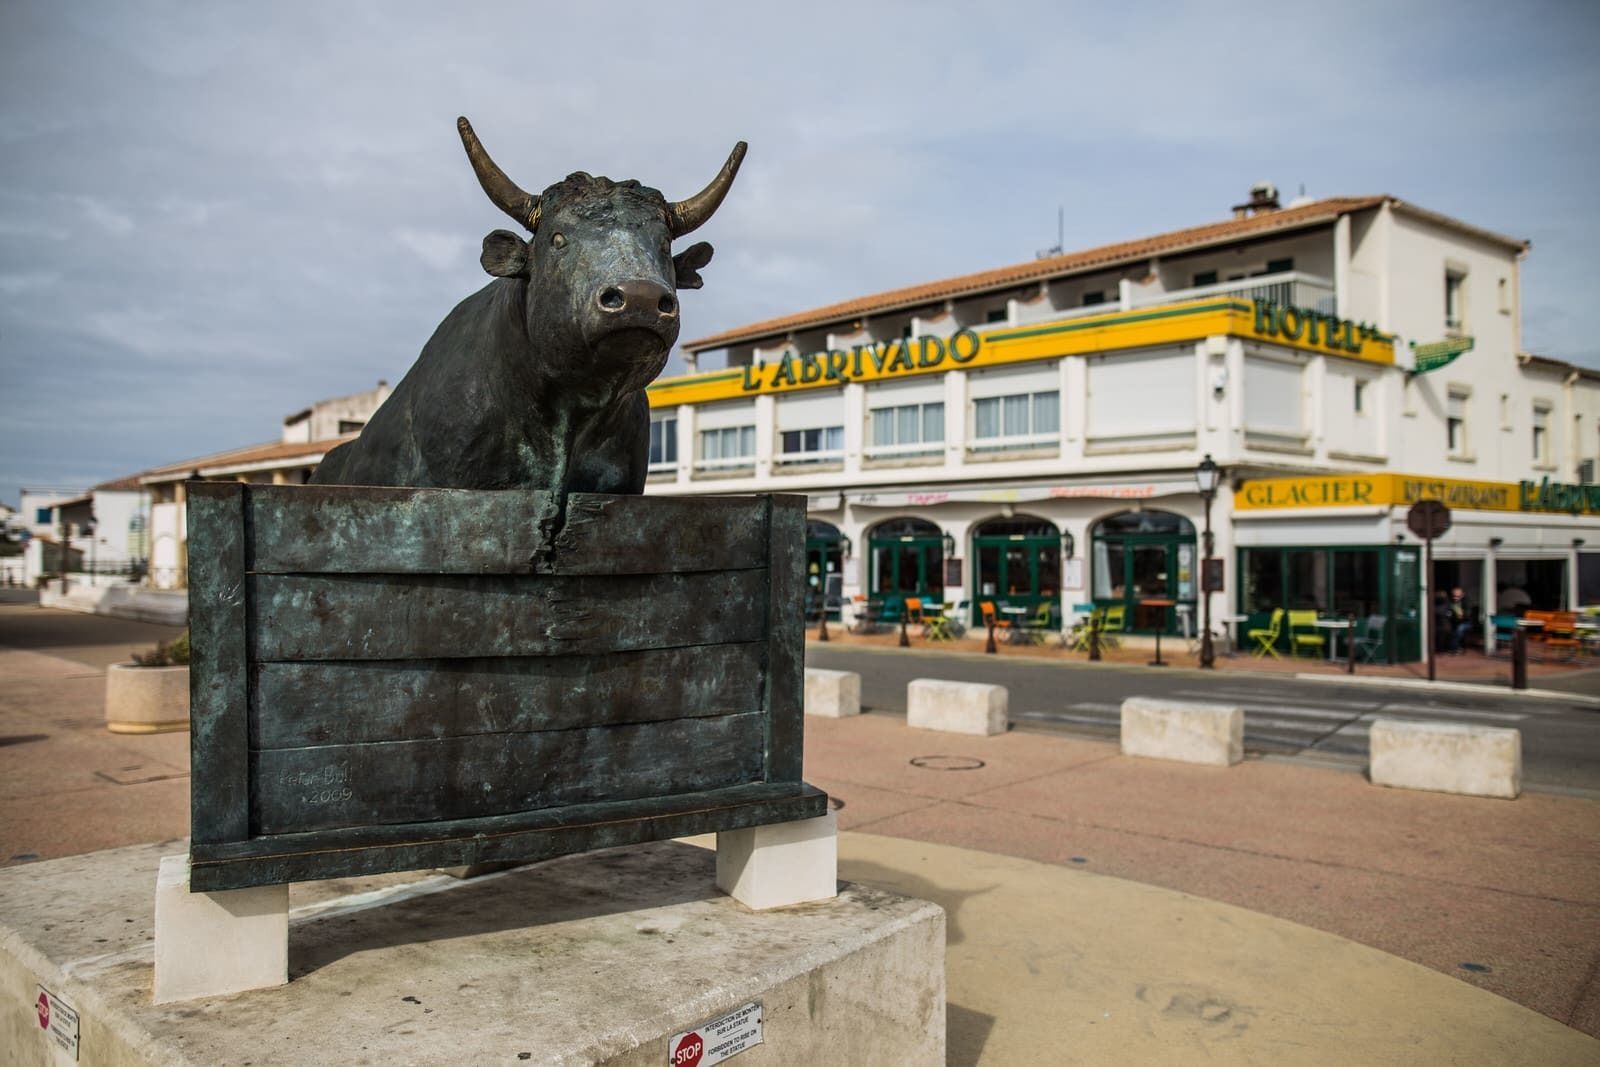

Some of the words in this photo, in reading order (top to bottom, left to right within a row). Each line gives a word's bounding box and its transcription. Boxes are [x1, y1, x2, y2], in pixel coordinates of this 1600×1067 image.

[742, 327, 981, 391] L'ABRIVADO
[1245, 480, 1375, 505] GLACIER
[309, 788, 352, 804] 2009
[704, 1015, 735, 1033] INTERDICTION
[735, 1011, 742, 1020] DE
[716, 1026, 727, 1036] SUR
[727, 1023, 733, 1031] LA
[733, 1016, 749, 1029] STATUE
[676, 1042, 701, 1064] STOP
[707, 1040, 734, 1056] FORBIDDEN
[720, 1049, 729, 1057] THE
[730, 1041, 745, 1054] STATUE
